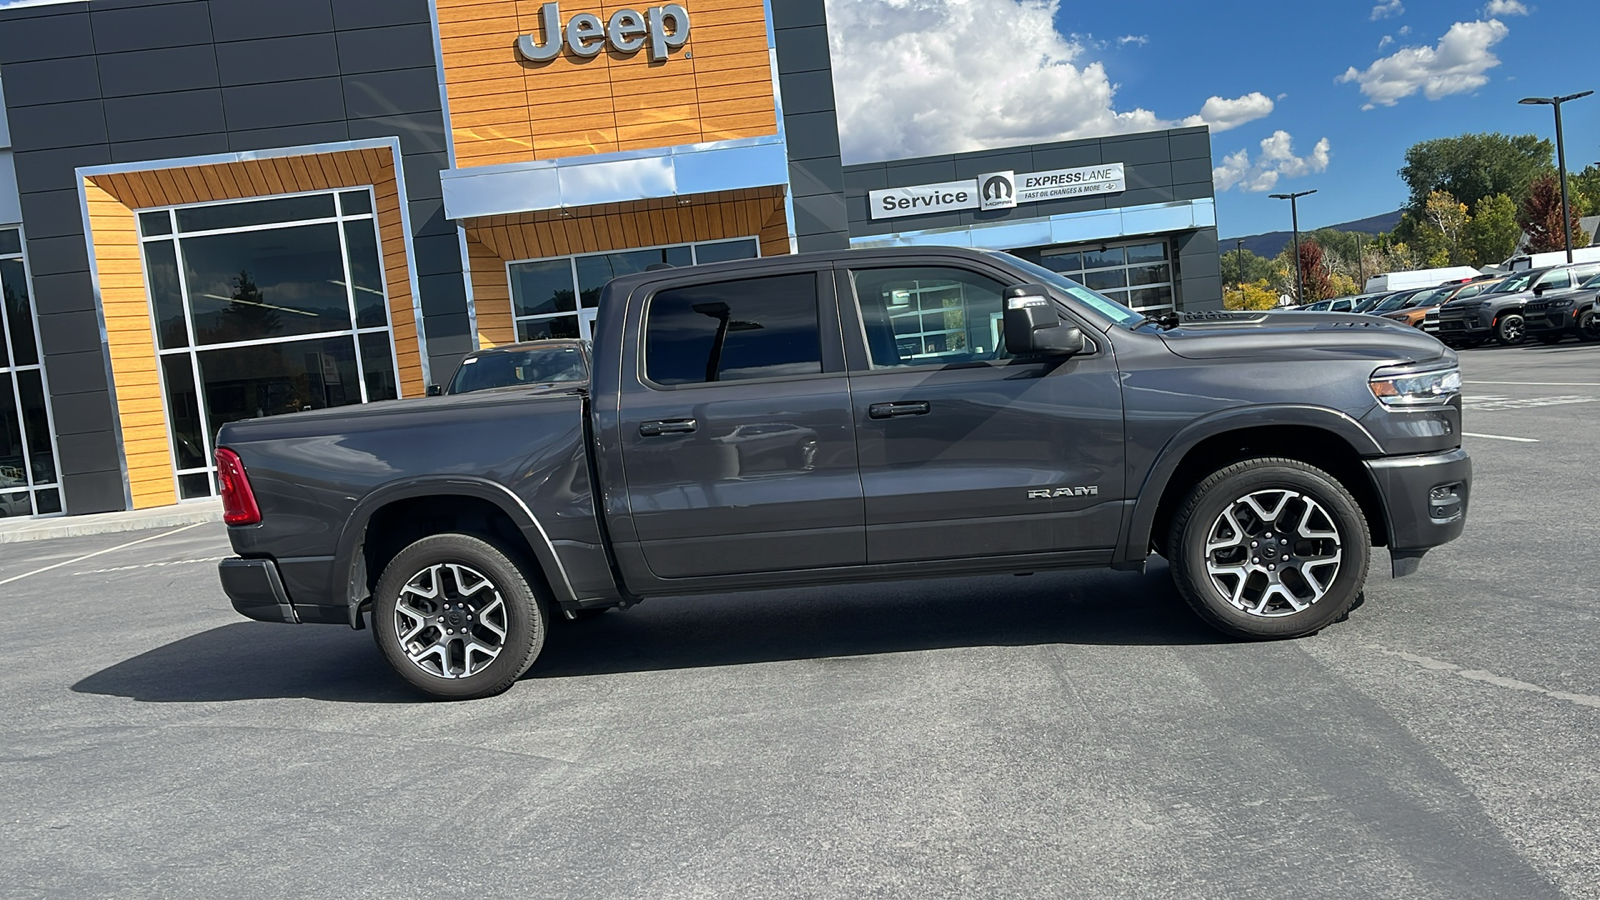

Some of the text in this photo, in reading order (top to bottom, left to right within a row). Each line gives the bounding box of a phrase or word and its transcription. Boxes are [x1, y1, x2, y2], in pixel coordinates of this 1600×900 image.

[518, 2, 691, 62] Jeep
[882, 190, 968, 211] Service
[1024, 191, 1039, 199] FAST
[1040, 190, 1049, 198] OIL
[1050, 187, 1077, 197] CHANGES
[1084, 185, 1101, 193] MORE
[1027, 485, 1098, 499] RAM
